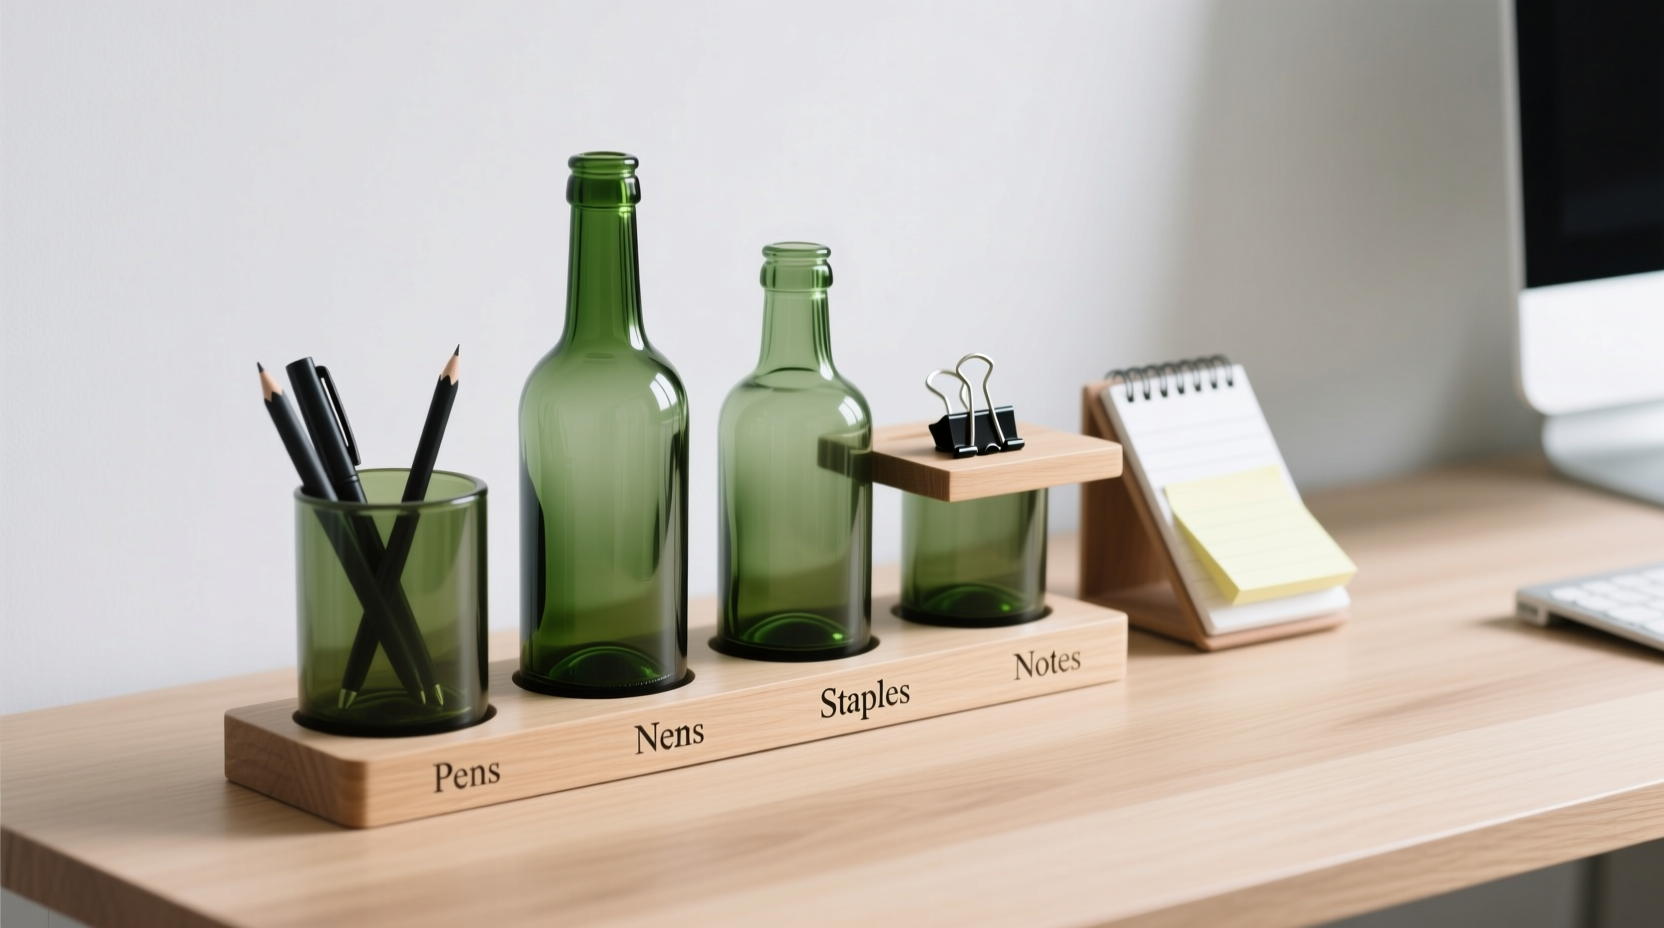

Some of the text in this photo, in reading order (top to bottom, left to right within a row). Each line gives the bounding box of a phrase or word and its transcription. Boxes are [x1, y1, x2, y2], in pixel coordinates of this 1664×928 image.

[1014, 650, 1081, 681] Notes
[820, 679, 910, 721] Staples
[635, 721, 705, 755] Nens
[433, 762, 501, 793] Pens
